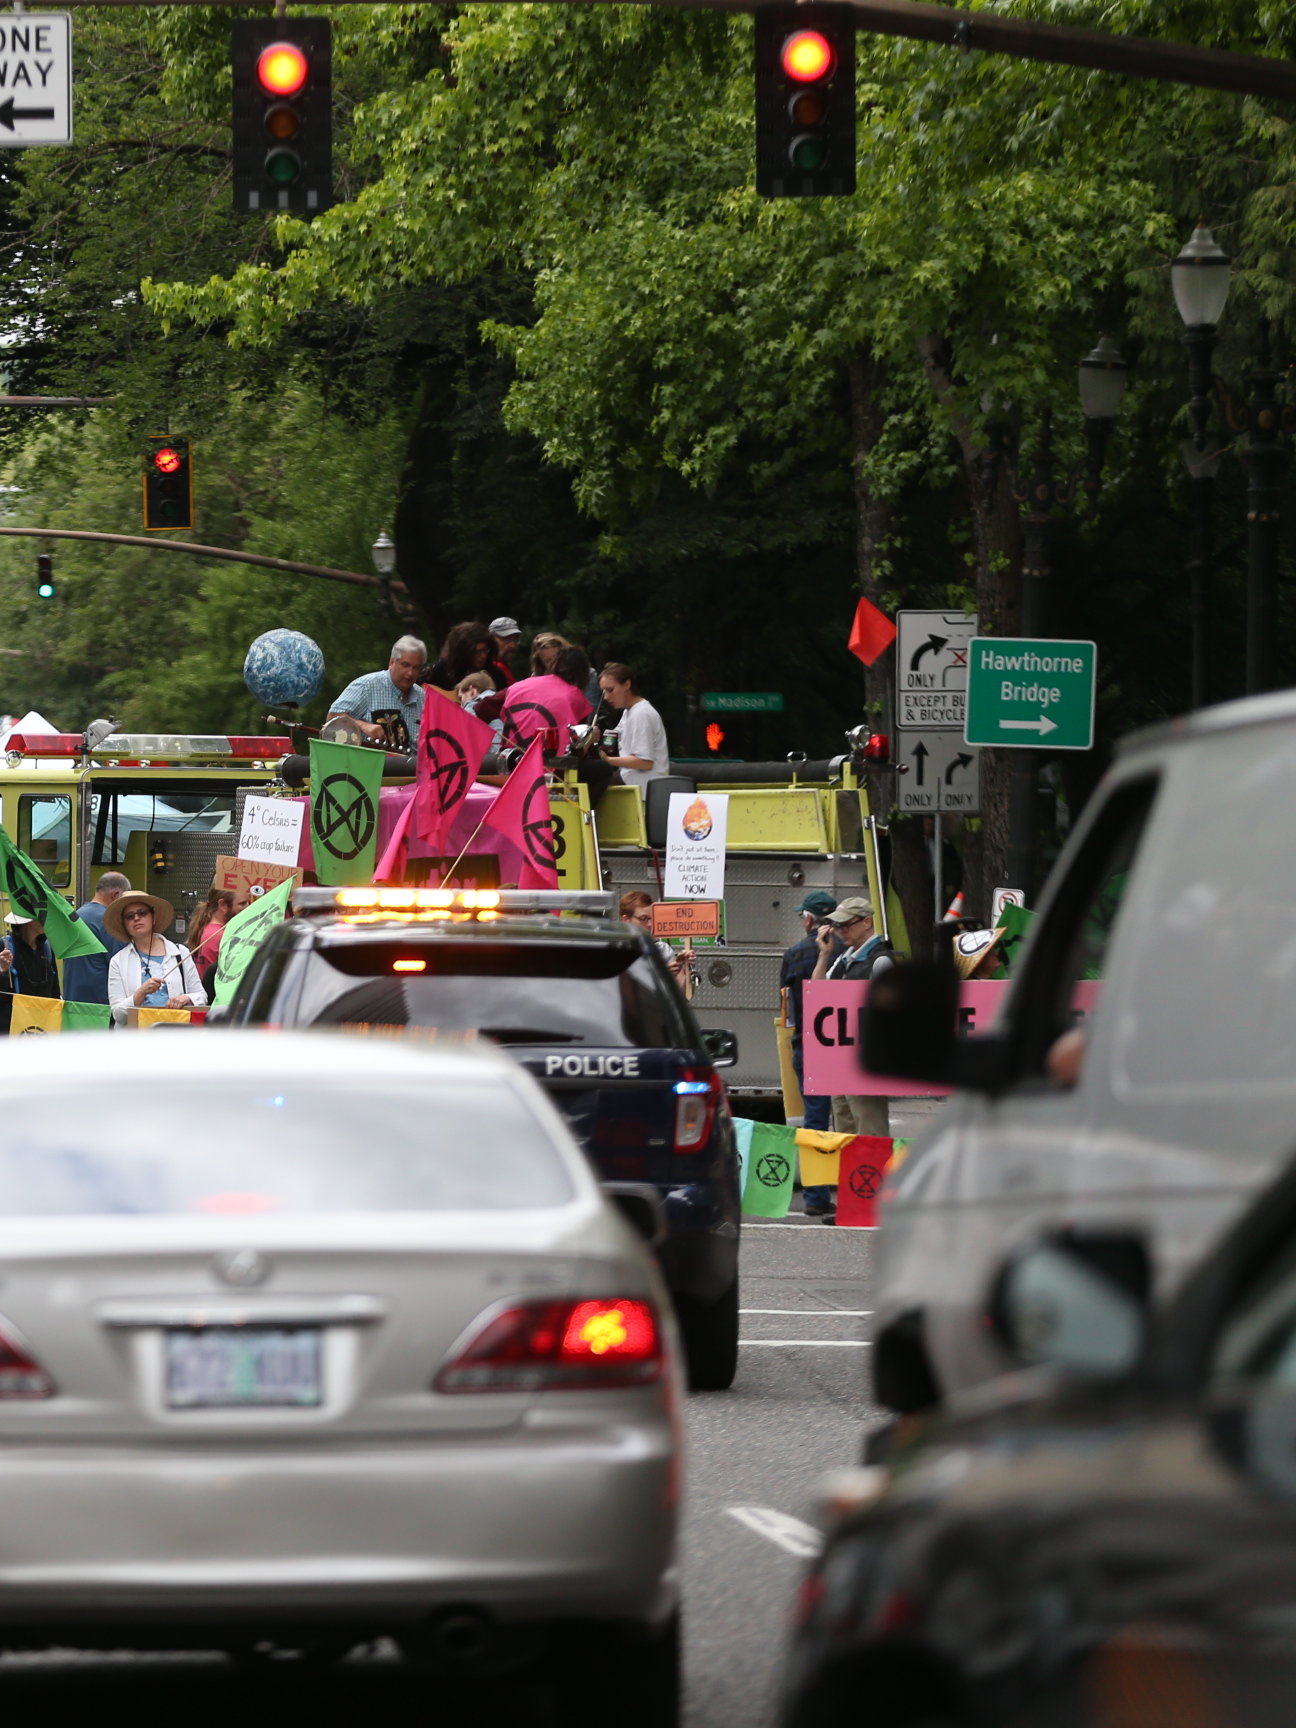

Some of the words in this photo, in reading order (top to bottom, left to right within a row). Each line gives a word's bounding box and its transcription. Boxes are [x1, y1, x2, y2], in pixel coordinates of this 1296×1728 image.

[981, 650, 1084, 673] Hawthorne
[907, 673, 936, 688] ONLY
[905, 695, 947, 707] EXCEPT
[951, 695, 965, 707] BU
[1001, 681, 1061, 708] Bridge
[717, 696, 765, 708] Madison
[905, 709, 915, 721] &
[921, 709, 965, 721] BICYCLE
[905, 793, 933, 807] ONLY
[945, 793, 974, 807] ONLY
[262, 809, 290, 827] Celsius
[241, 834, 260, 850] 60%
[260, 841, 274, 854] crop
[274, 838, 294, 853] failure
[222, 858, 260, 875] OPEN
[678, 864, 709, 873] CLIMATE
[224, 873, 286, 894] EYE
[681, 874, 707, 882] ACTION
[684, 884, 707, 895] NOW
[676, 907, 694, 918] END
[657, 921, 715, 932] DESTRUCTION
[546, 1055, 640, 1077] POLICE
